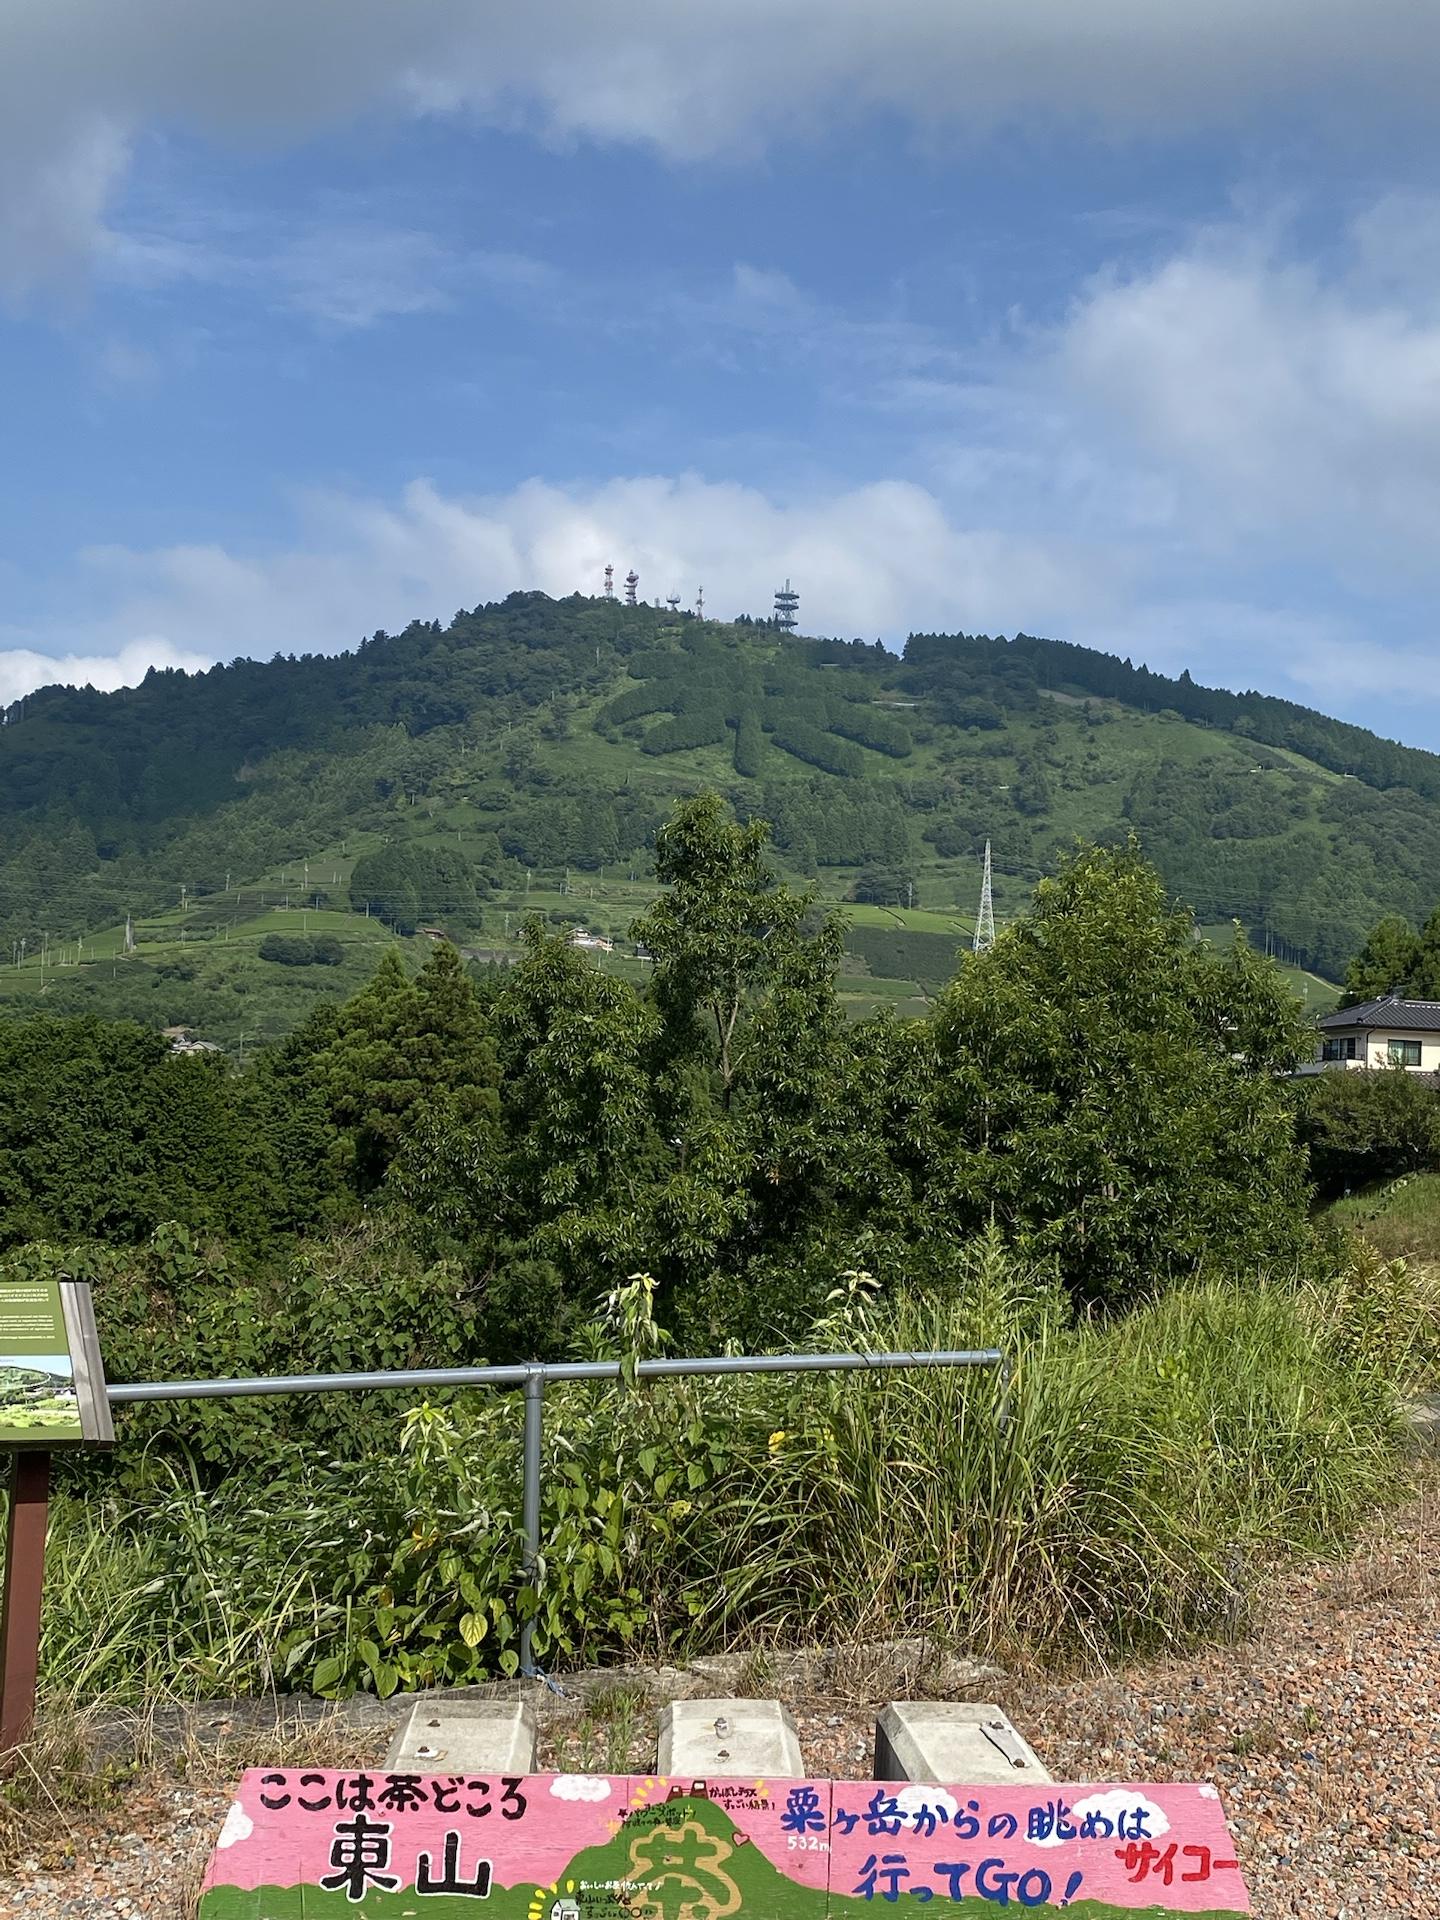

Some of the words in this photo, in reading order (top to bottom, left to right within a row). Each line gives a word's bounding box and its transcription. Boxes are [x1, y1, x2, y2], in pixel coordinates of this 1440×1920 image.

[259, 1773, 528, 1820] ここは茶どころ
[318, 1812, 494, 1902] 東山
[787, 1835, 832, 1852] 532m
[1114, 1841, 1239, 1887] サイコー
